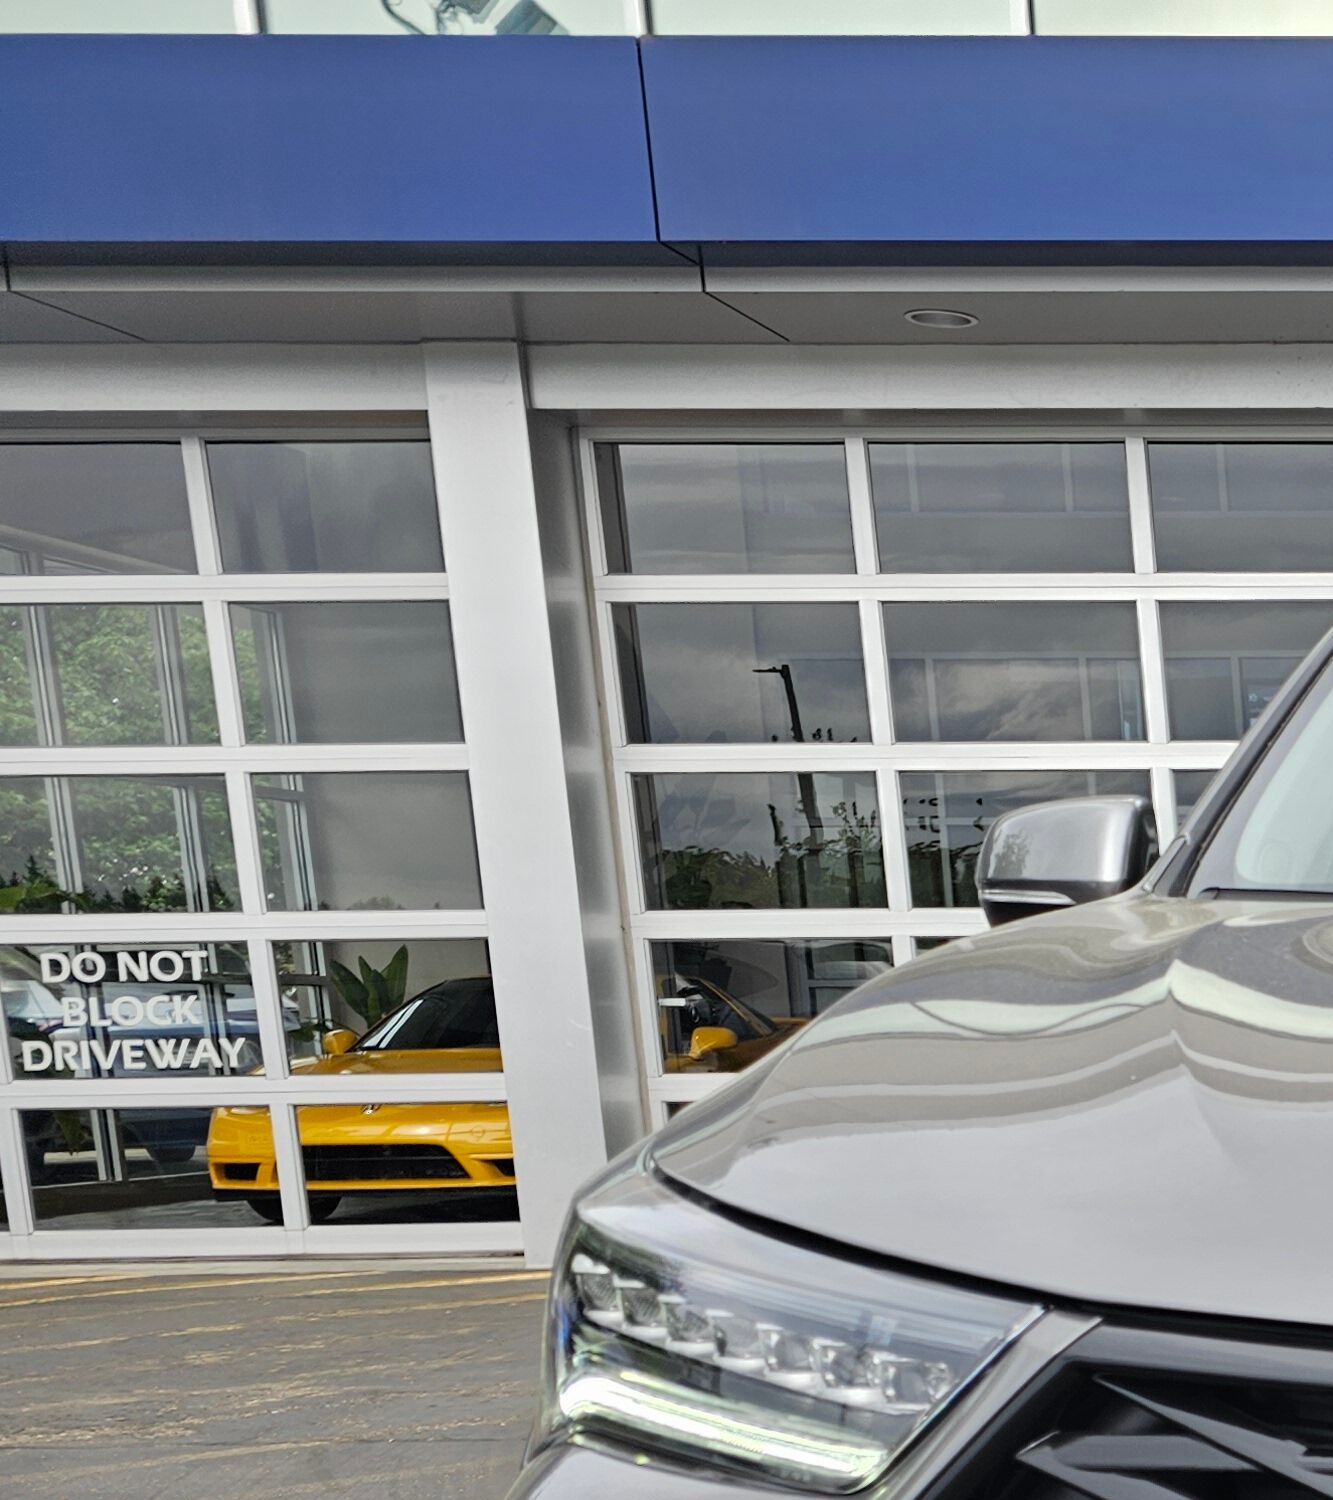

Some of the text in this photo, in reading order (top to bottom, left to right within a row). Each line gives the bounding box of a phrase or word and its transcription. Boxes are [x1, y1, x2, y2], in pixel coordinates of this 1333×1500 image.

[40, 950, 208, 984] DO NOT
[60, 994, 201, 1027] BLOCK
[21, 1037, 246, 1072] DRIVEWAY
